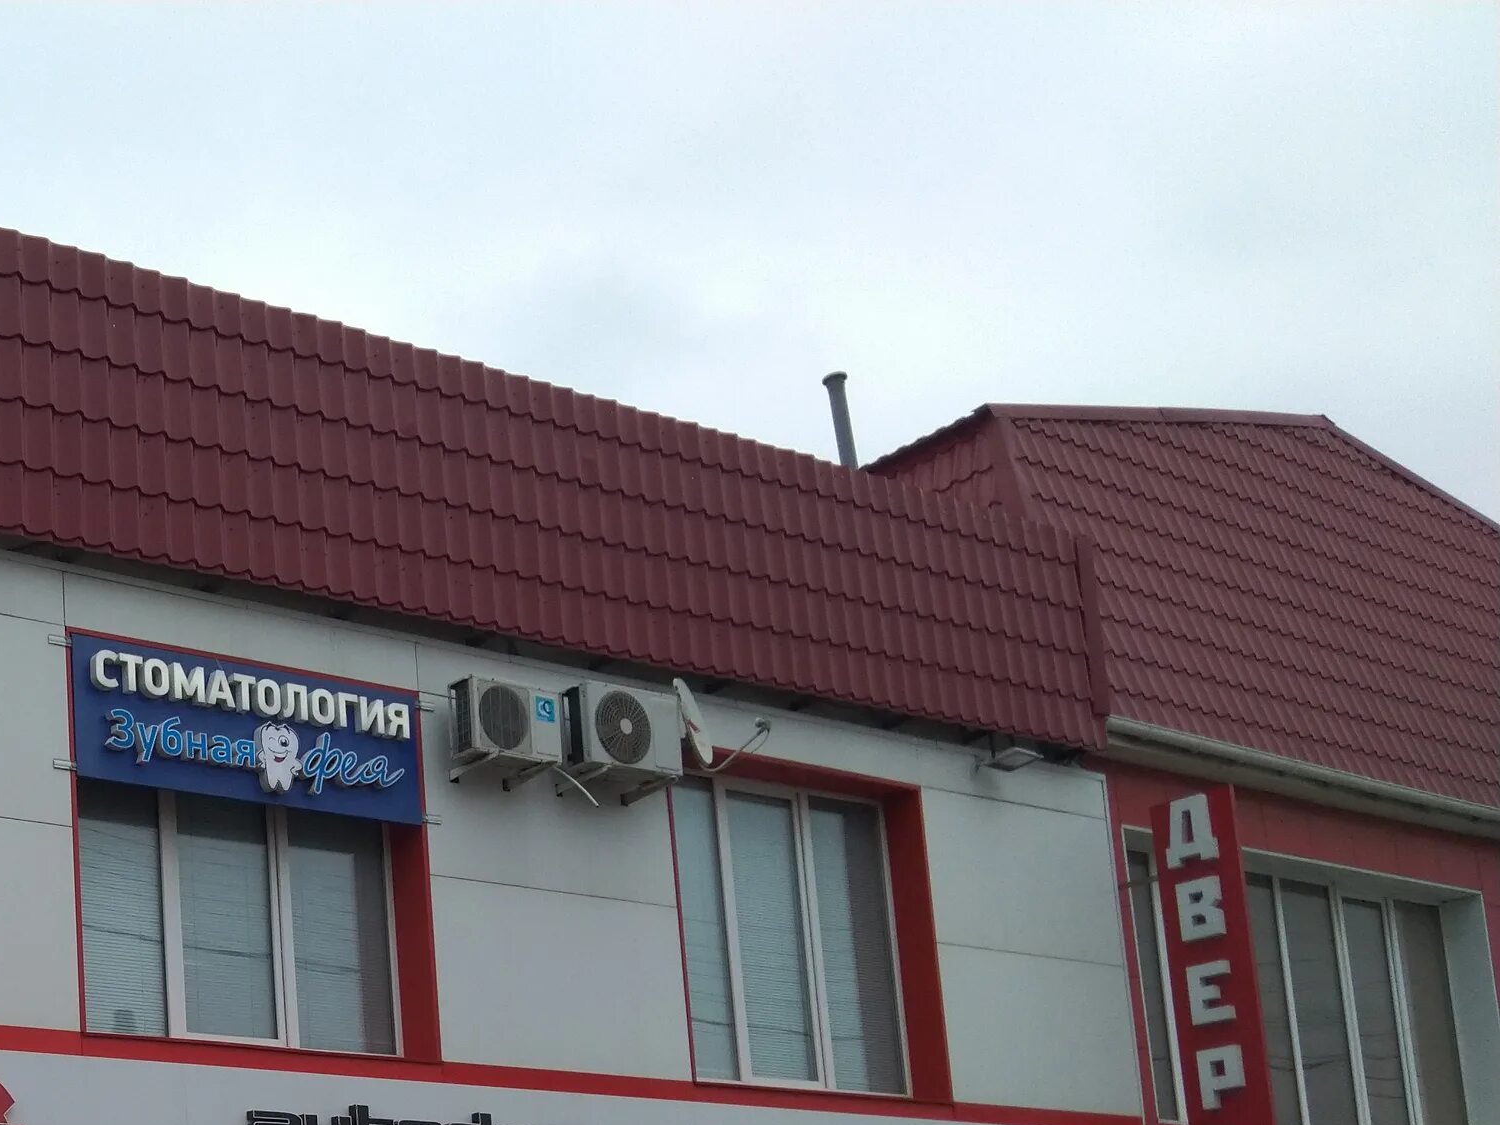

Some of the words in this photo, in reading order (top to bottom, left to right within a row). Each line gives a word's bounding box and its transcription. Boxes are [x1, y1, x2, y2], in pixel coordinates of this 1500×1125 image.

[90, 650, 411, 740] СТОМАТОЛОГИЯ
[104, 708, 256, 765] Зубная
[303, 732, 405, 795] фея
